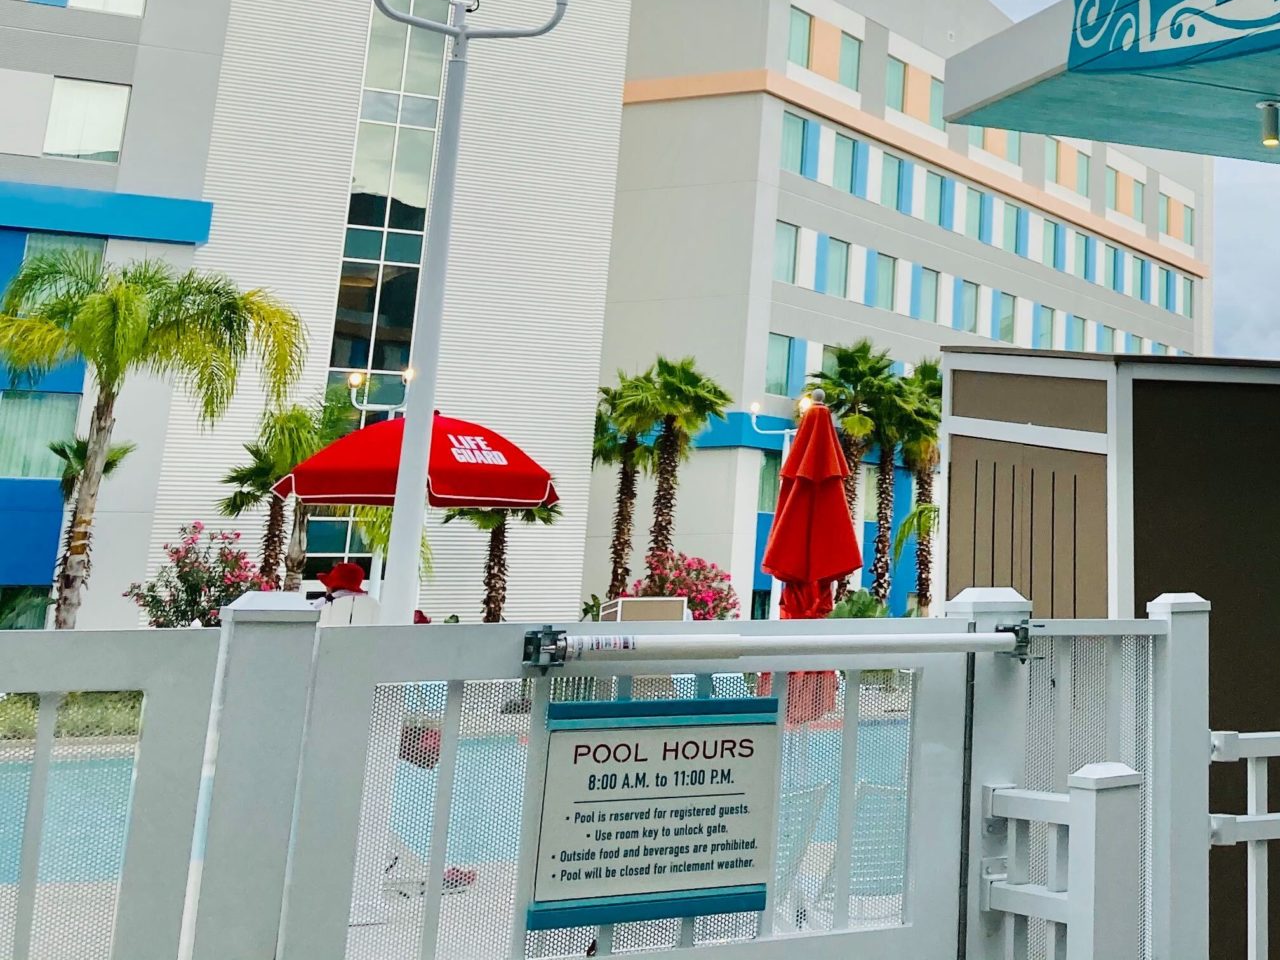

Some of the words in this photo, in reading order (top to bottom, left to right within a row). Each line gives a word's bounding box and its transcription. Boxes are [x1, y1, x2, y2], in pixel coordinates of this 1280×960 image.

[447, 434, 493, 450] LIFE
[450, 448, 509, 466] GUARD
[573, 743, 648, 765] POOL
[662, 738, 755, 761] HOURS
[588, 774, 617, 791] 8:00
[621, 772, 650, 790] A.M.
[655, 772, 668, 787] to
[673, 769, 706, 786] 11:00
[710, 768, 735, 785] P.M.
[574, 810, 595, 824] Pool
[597, 811, 606, 823] is
[609, 807, 651, 822] reserved
[653, 807, 667, 820] for
[669, 804, 717, 821] registered
[718, 803, 751, 819] guests.
[594, 828, 613, 841] Use
[615, 829, 640, 840] room
[642, 826, 659, 841] key
[661, 825, 671, 837] to
[673, 823, 704, 837] unlock
[706, 822, 729, 837] gate.
[560, 848, 596, 863] Outside
[599, 846, 620, 860] food
[623, 844, 641, 858] and
[643, 843, 690, 858] beverages
[692, 843, 708, 854] are
[710, 838, 759, 855] prohibited.
[560, 868, 581, 882] Pool
[584, 866, 602, 880] will
[605, 865, 617, 878] be
[619, 863, 651, 878] closed
[653, 862, 667, 875] for
[669, 860, 715, 874] inclement
[717, 856, 756, 871] weather.
